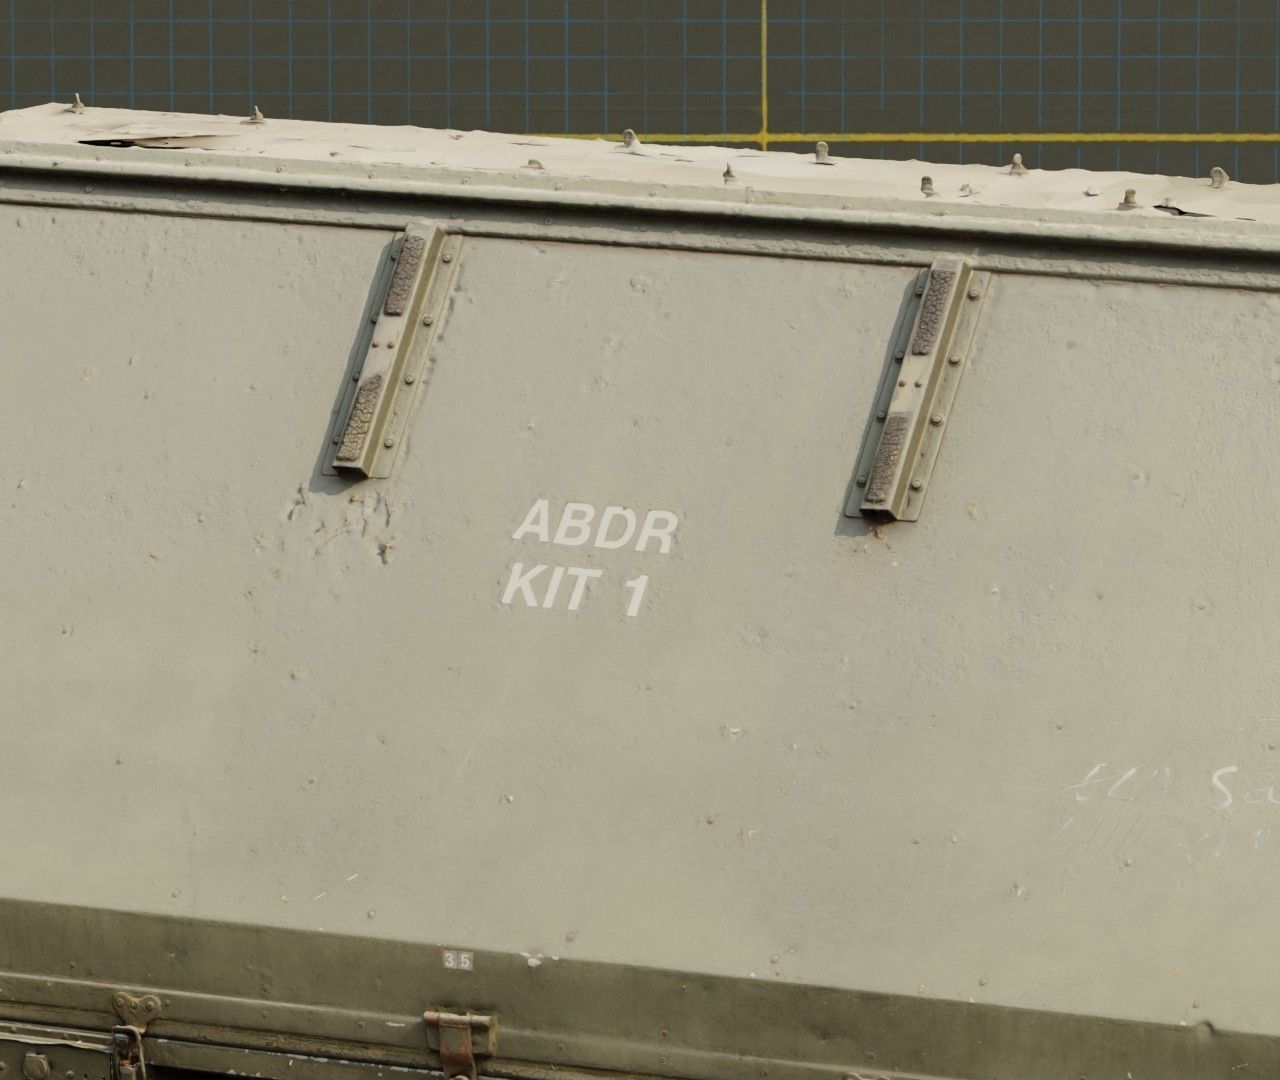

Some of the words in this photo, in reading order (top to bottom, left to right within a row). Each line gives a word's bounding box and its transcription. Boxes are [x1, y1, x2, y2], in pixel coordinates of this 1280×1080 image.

[511, 499, 679, 554] ABDR
[501, 562, 603, 611] KIT
[625, 574, 649, 617] 1
[443, 952, 471, 969] 35
